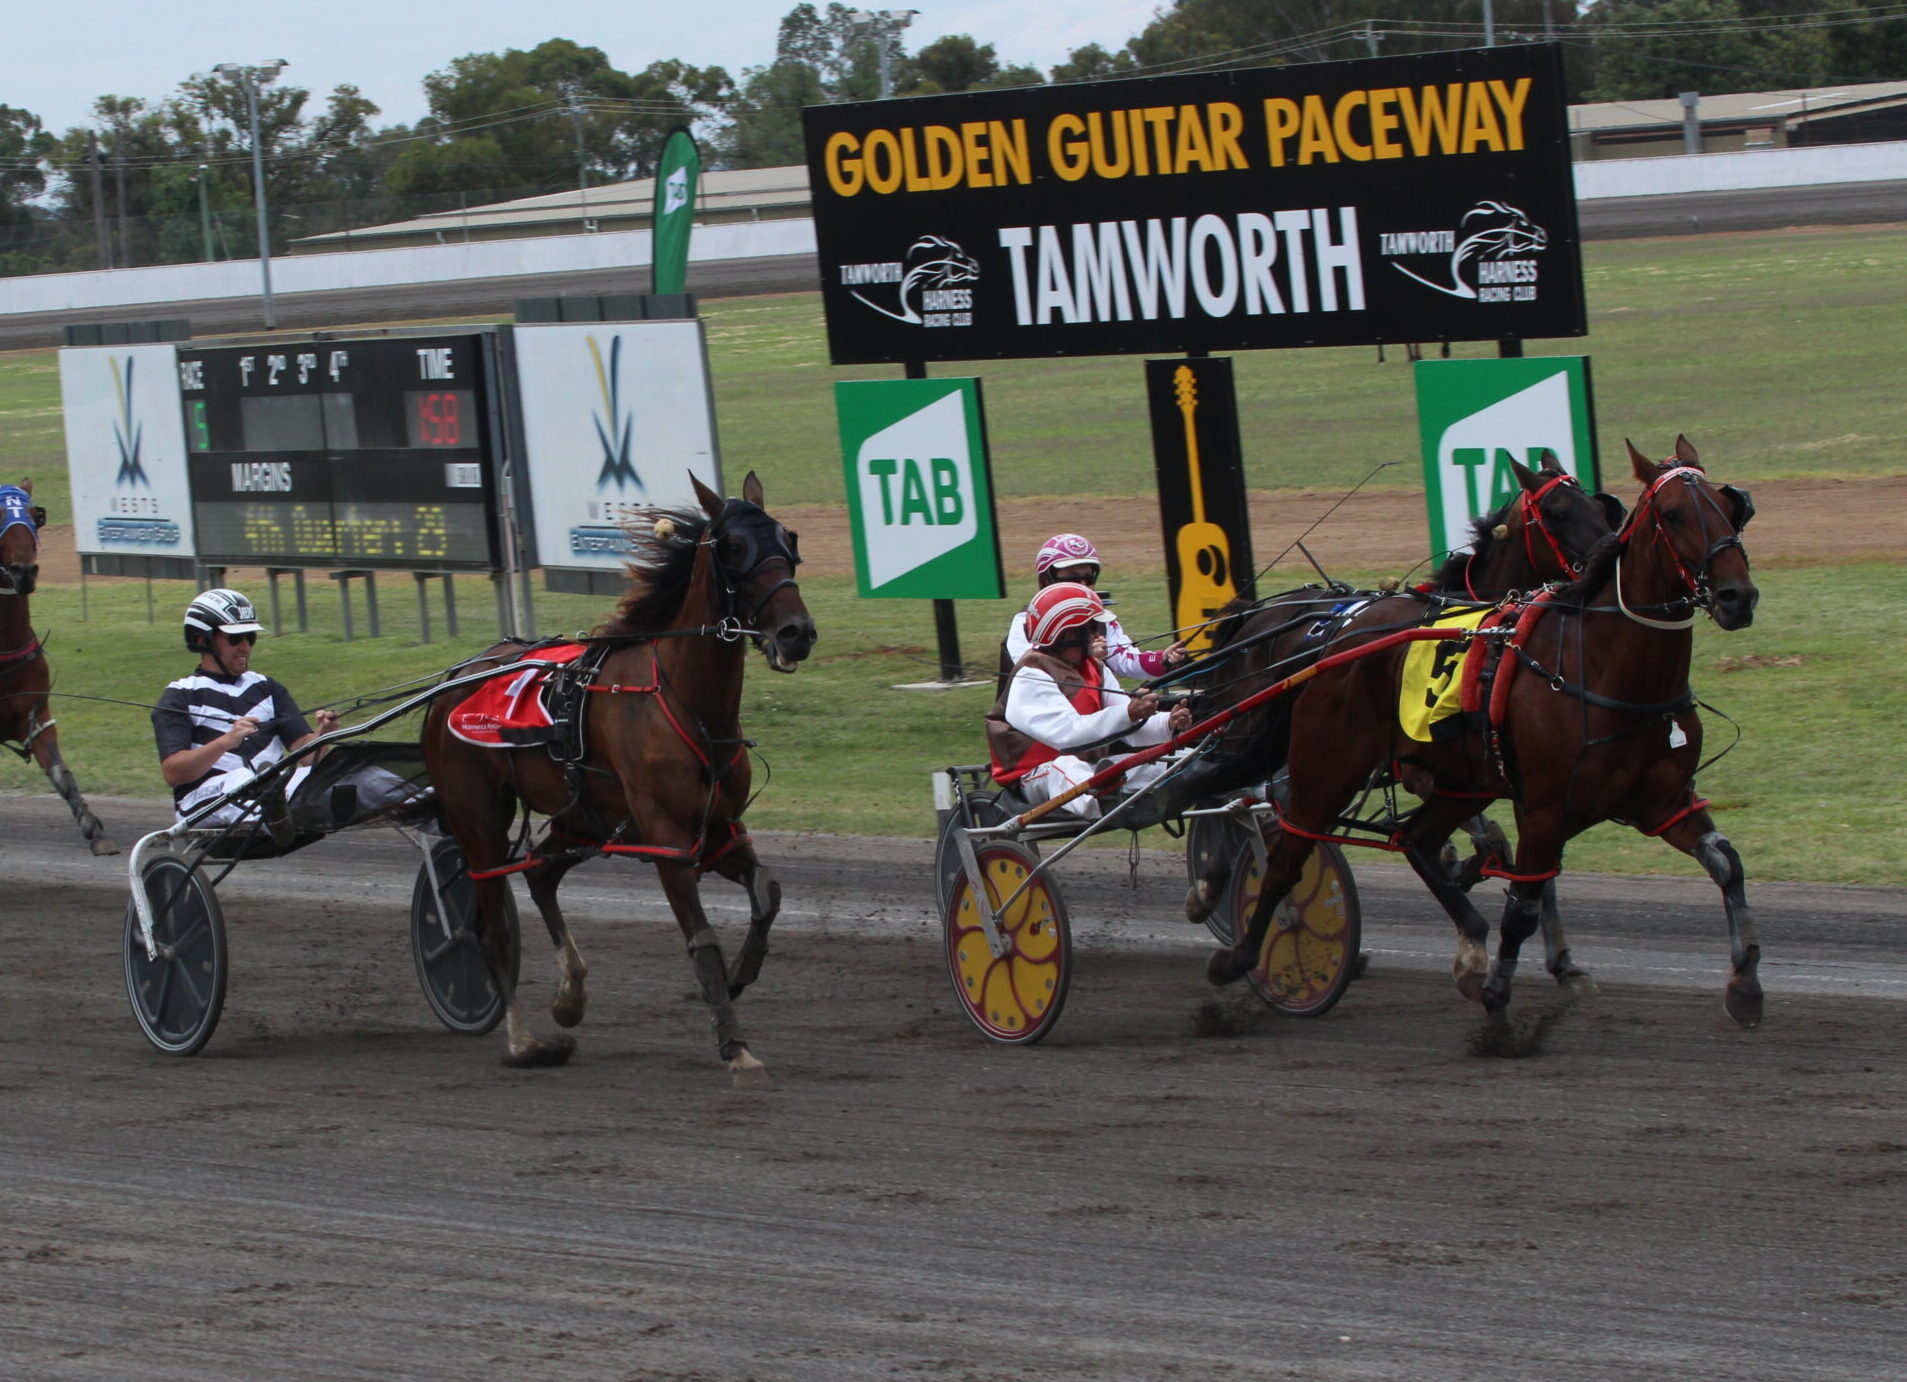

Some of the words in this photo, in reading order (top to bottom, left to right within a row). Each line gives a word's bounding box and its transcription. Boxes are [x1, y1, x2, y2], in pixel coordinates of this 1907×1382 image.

[825, 119, 1032, 197] GOLDEN
[1047, 102, 1250, 181] GUITAR
[1263, 77, 1532, 168] PACEWAY
[1379, 230, 1455, 255] TAMWORTH
[840, 262, 903, 285] TAMWORTH
[998, 206, 1366, 326] TAMWORTH
[1478, 259, 1538, 284] HARNESS
[922, 289, 973, 311] HARNESS
[1478, 287, 1511, 303] RACING
[1512, 286, 1537, 301] CLUB
[922, 313, 951, 328] RACING
[952, 312, 972, 327] CLUB
[416, 348, 455, 380] TIME
[193, 402, 210, 450] 5
[230, 462, 292, 492] MARGINS
[869, 457, 964, 526] TAB
[1425, 638, 1470, 708] 5
[505, 669, 540, 720] 1
